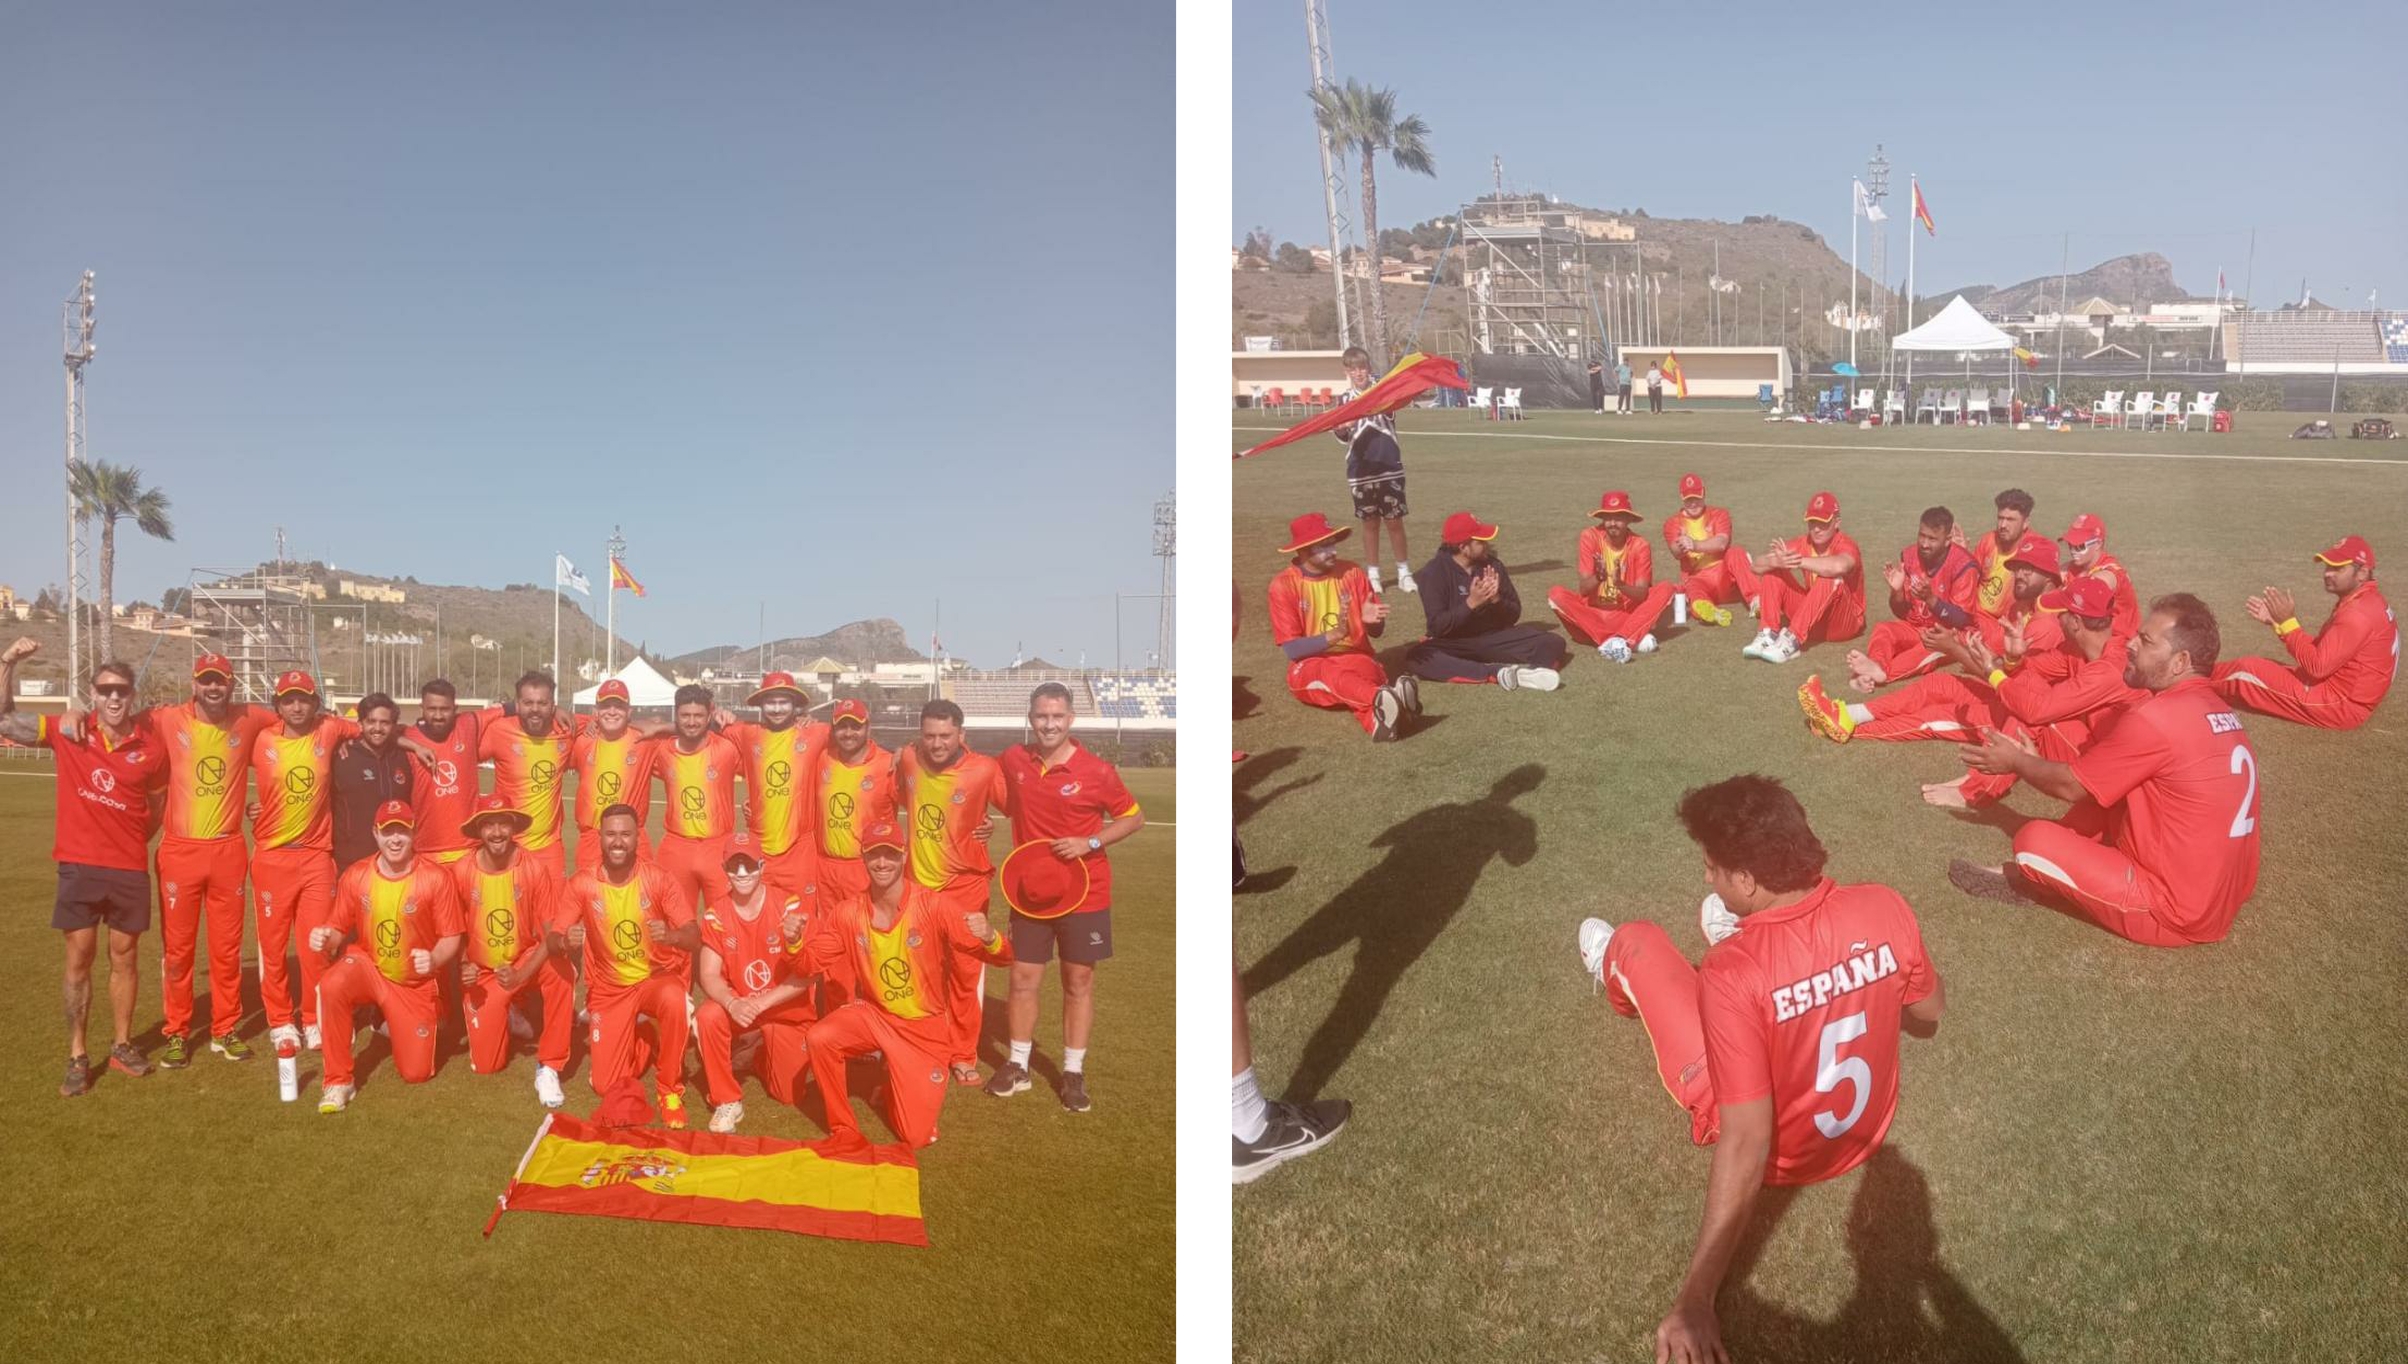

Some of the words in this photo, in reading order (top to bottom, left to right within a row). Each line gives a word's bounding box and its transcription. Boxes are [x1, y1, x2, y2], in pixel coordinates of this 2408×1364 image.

[2229, 744, 2257, 838] 2
[168, 897, 176, 910] 7
[265, 906, 272, 918] 5
[1770, 939, 1899, 1026] ESPAÑA
[1813, 1010, 1873, 1140] 5
